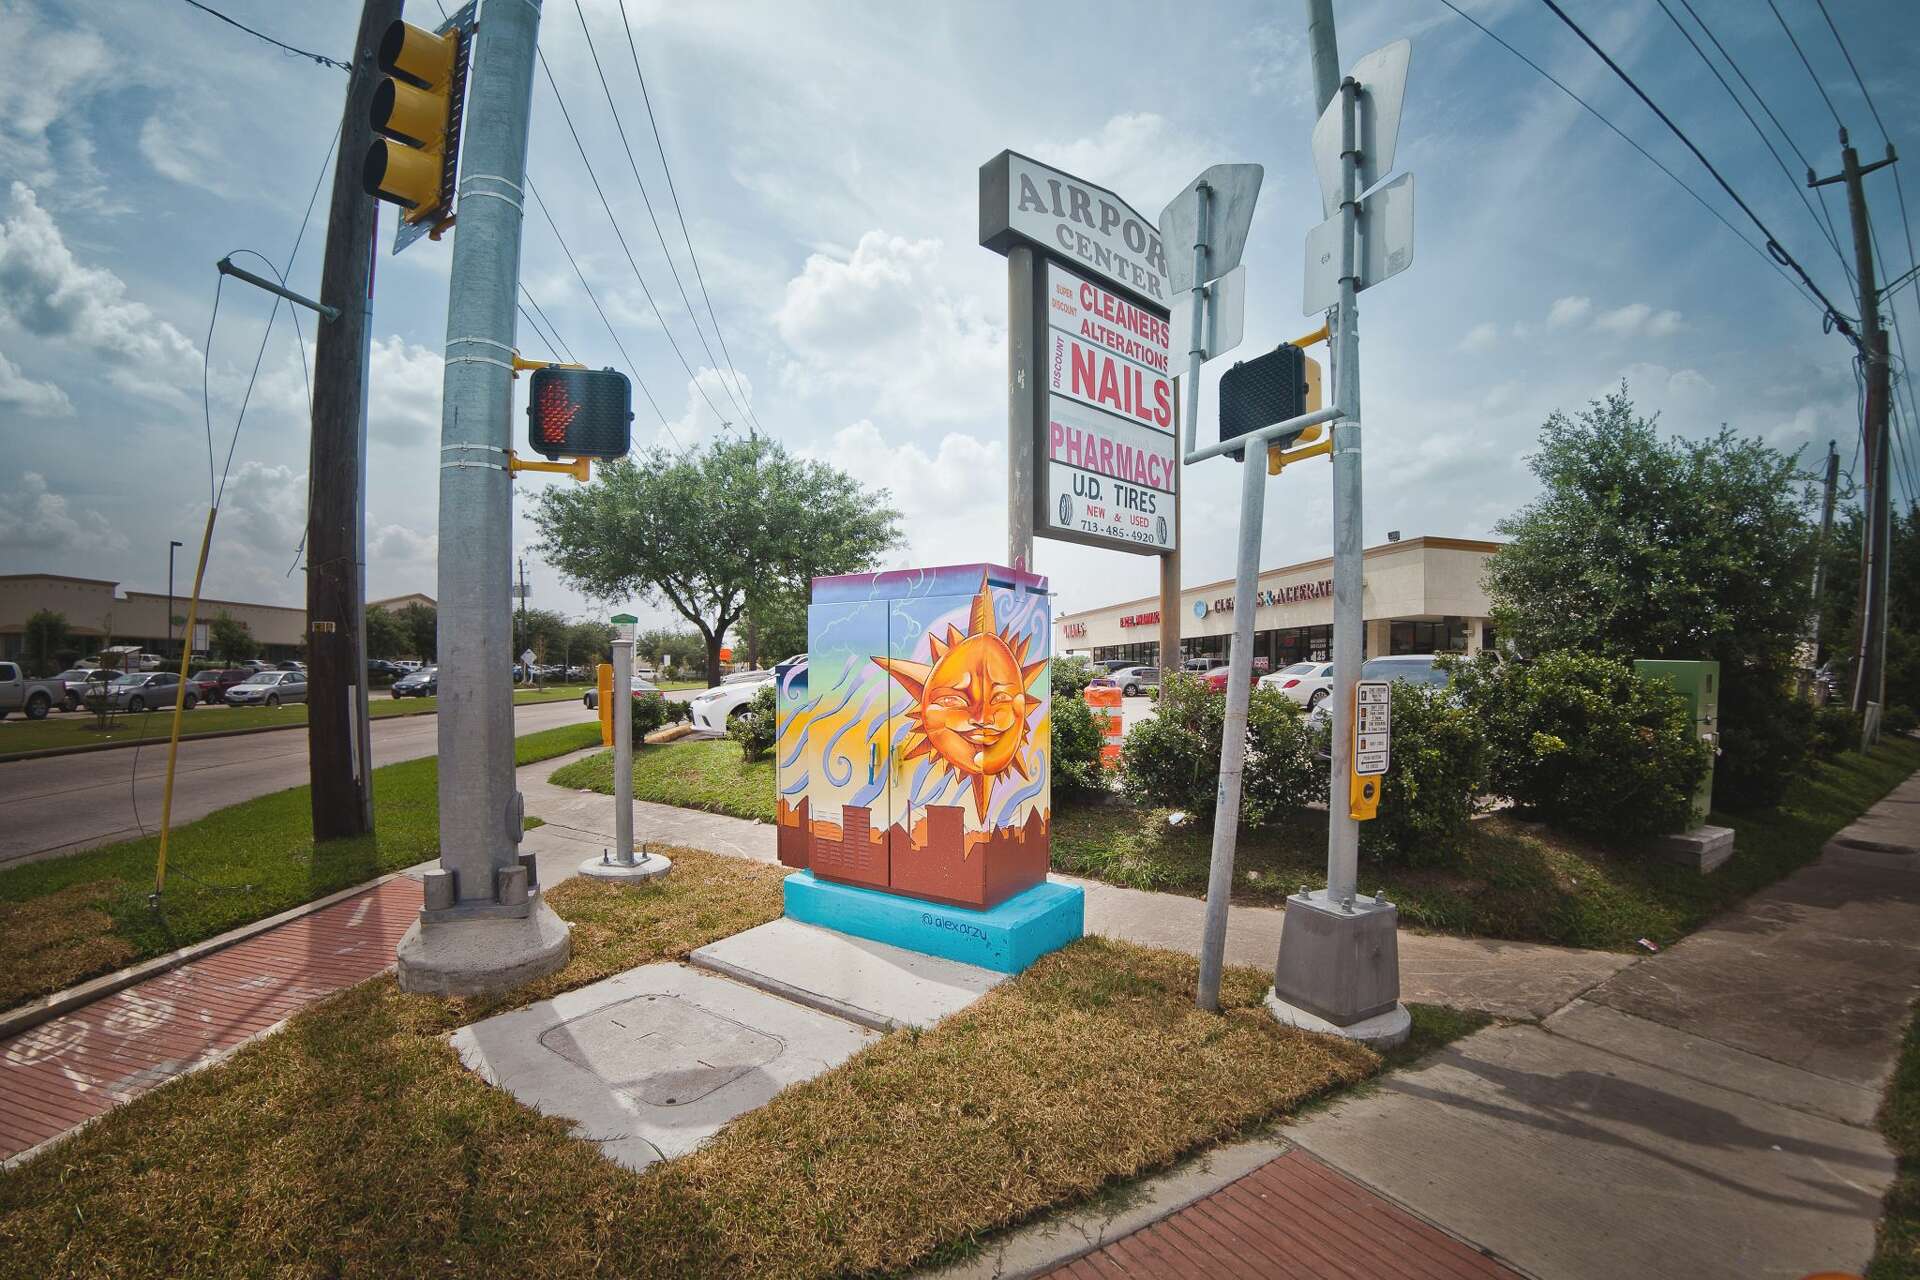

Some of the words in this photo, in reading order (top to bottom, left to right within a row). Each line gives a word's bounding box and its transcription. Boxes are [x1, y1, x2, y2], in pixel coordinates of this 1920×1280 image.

[1018, 173, 1168, 278] AIRPOR
[1056, 223, 1163, 300] CENTER
[1052, 298, 1077, 317] DISCOUNT
[1056, 284, 1073, 298] SUPER
[1080, 281, 1169, 349] CLEANERS
[1053, 335, 1065, 389] DISCOUNT
[1081, 318, 1168, 373] ALTERATIONS
[1071, 341, 1171, 427] NAILS
[1050, 421, 1175, 492] PHARMACY
[1073, 473, 1103, 501] U.D.
[1114, 484, 1156, 514] TIRES
[1087, 505, 1106, 519] NEW
[1114, 513, 1121, 522] &
[1130, 515, 1149, 528] USED
